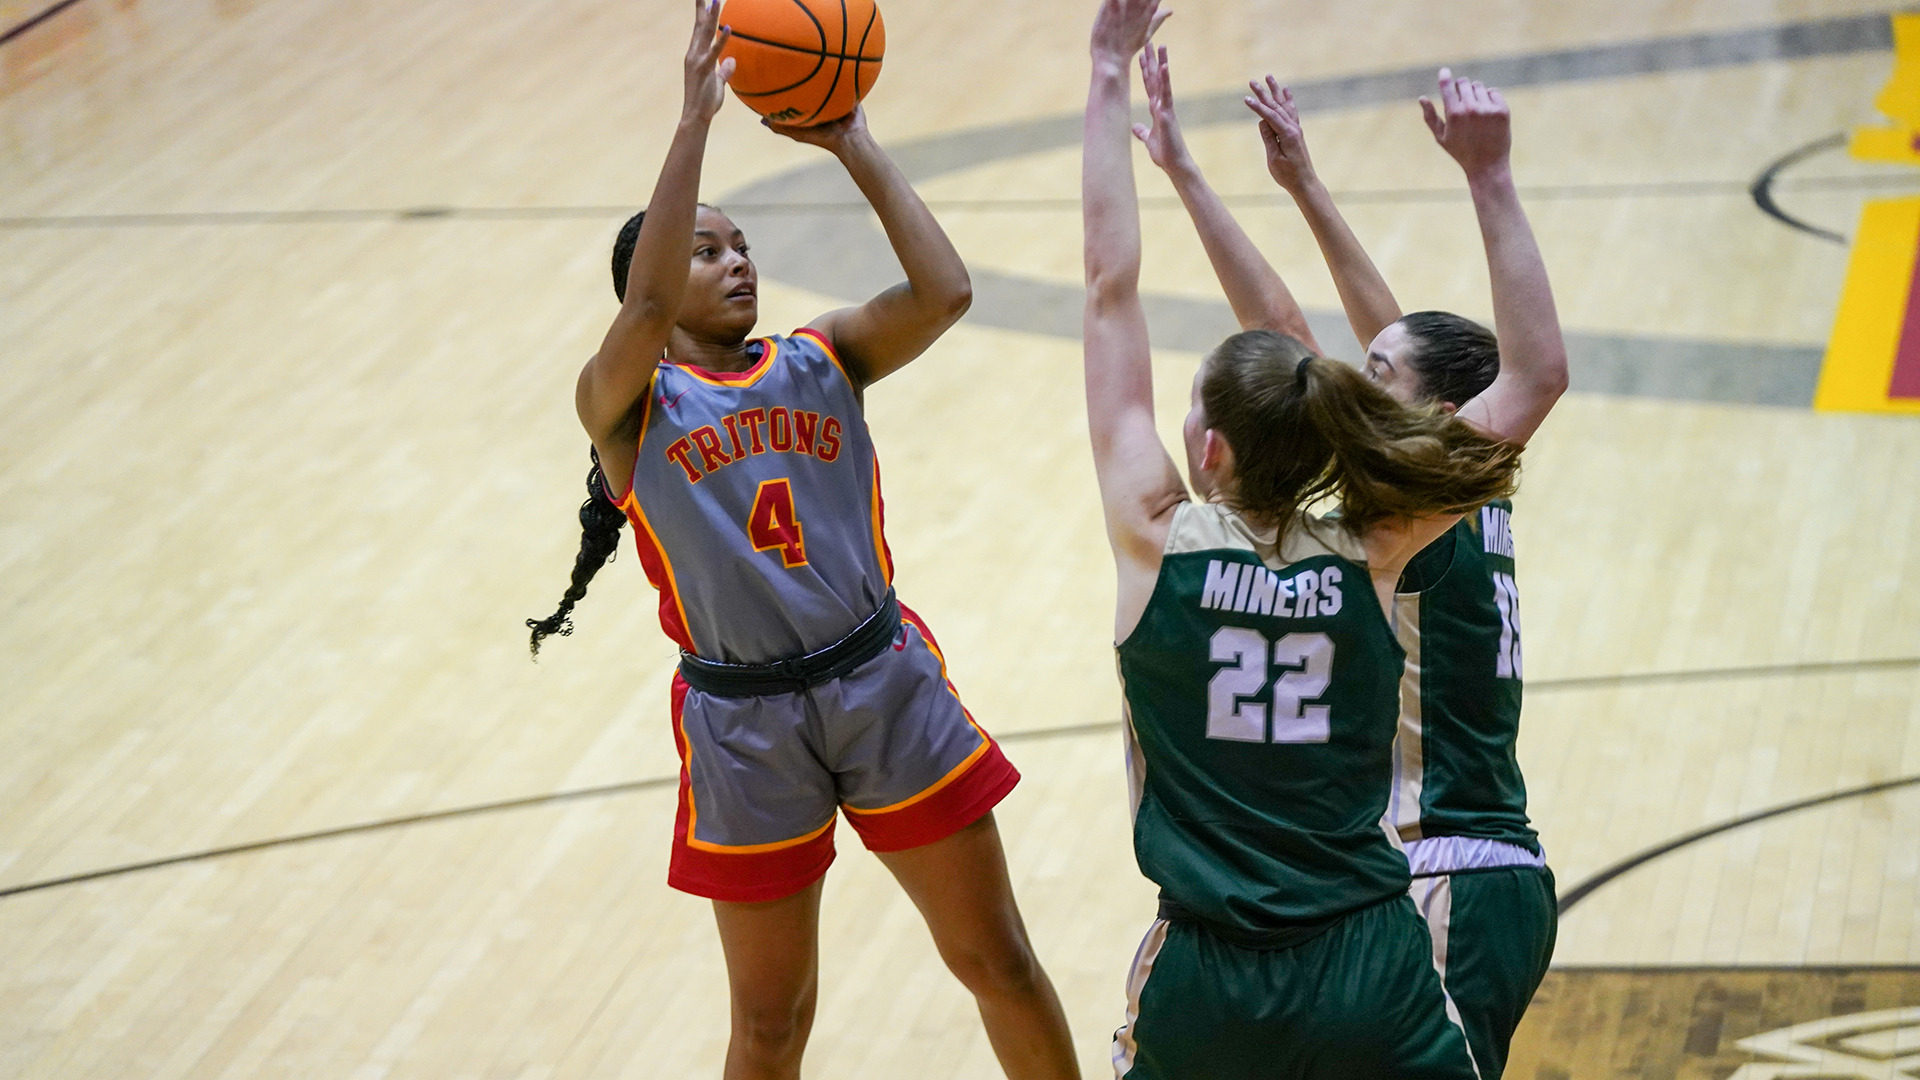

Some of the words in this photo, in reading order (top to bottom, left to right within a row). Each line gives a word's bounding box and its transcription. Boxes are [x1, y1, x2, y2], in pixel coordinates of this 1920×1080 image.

[665, 406, 842, 484] TRITONS
[747, 477, 809, 568] 4
[1200, 559, 1343, 619] MINERS
[1206, 625, 1336, 744] 22
